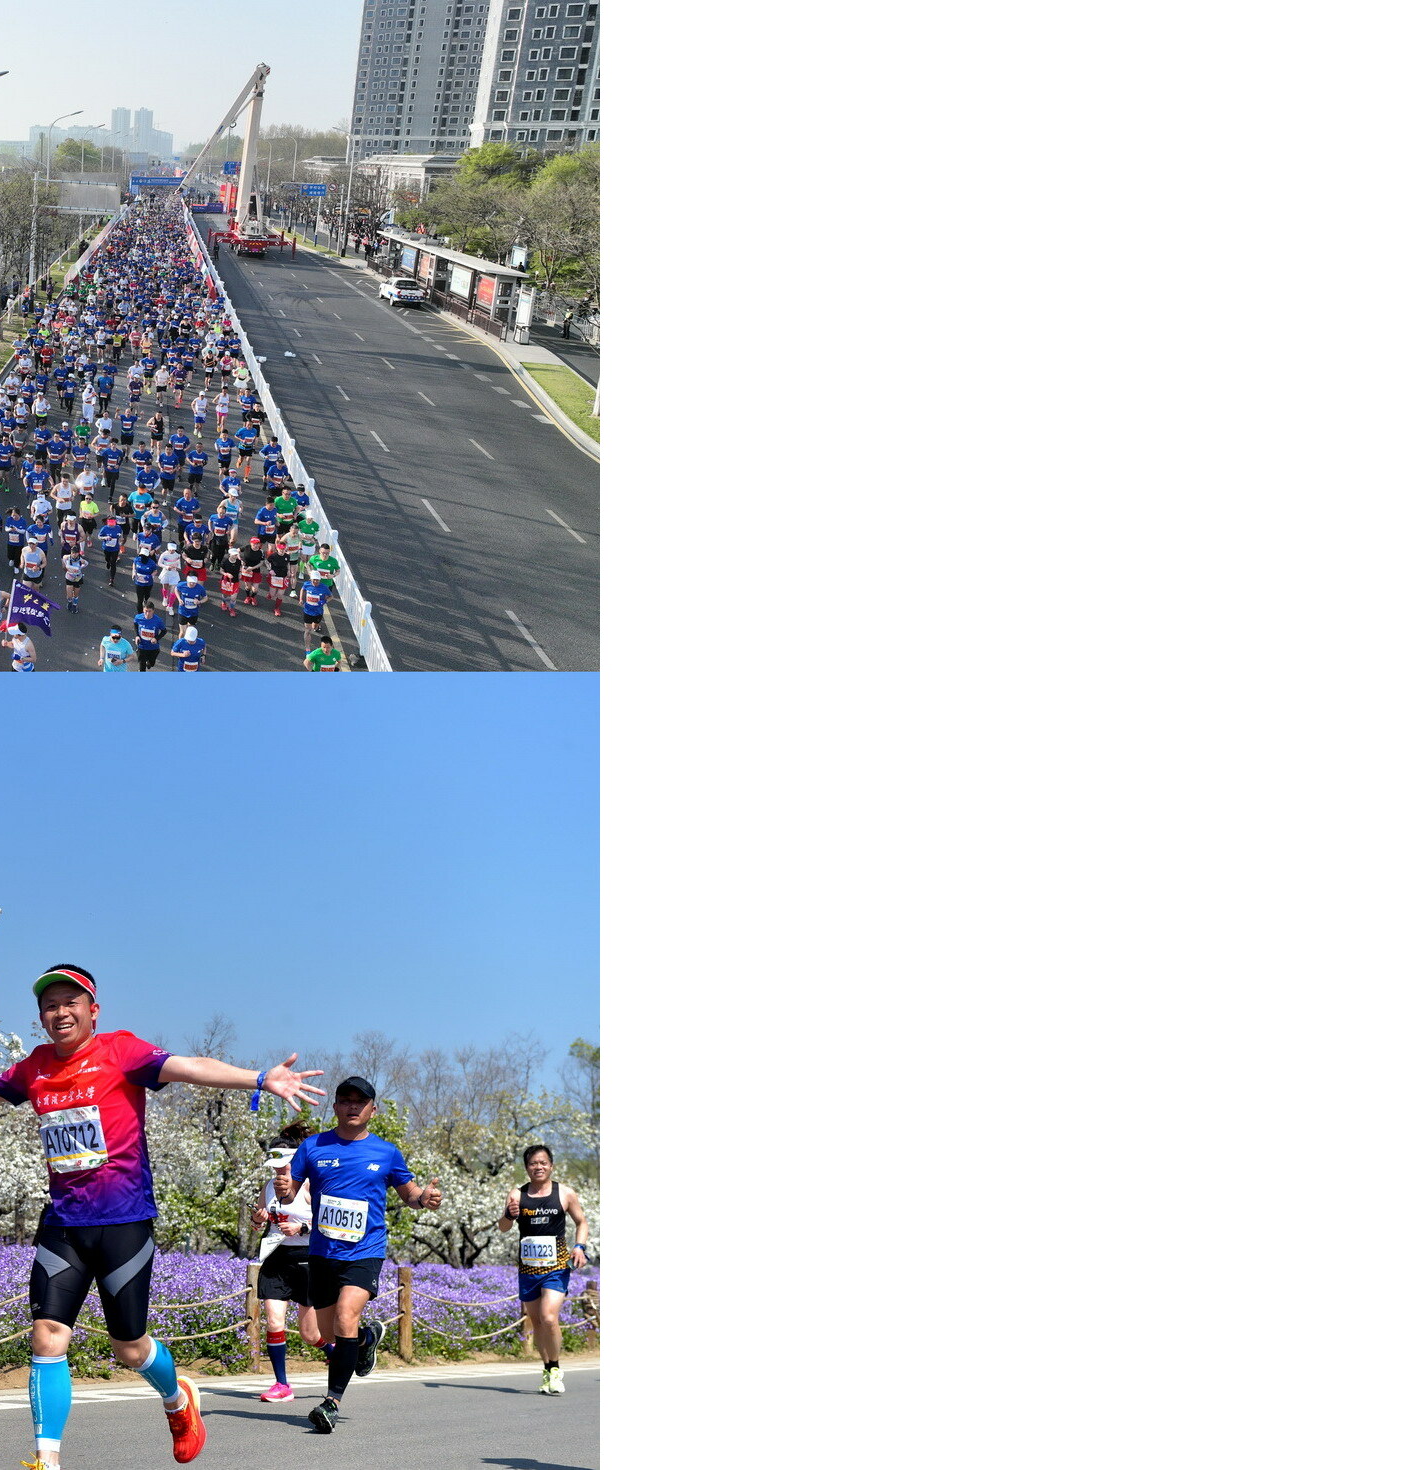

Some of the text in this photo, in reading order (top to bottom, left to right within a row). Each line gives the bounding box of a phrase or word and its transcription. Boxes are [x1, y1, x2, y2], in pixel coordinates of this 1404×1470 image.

[46, 1123, 99, 1154] A10712
[321, 1207, 362, 1229] A10513
[524, 1245, 553, 1257] B11223
